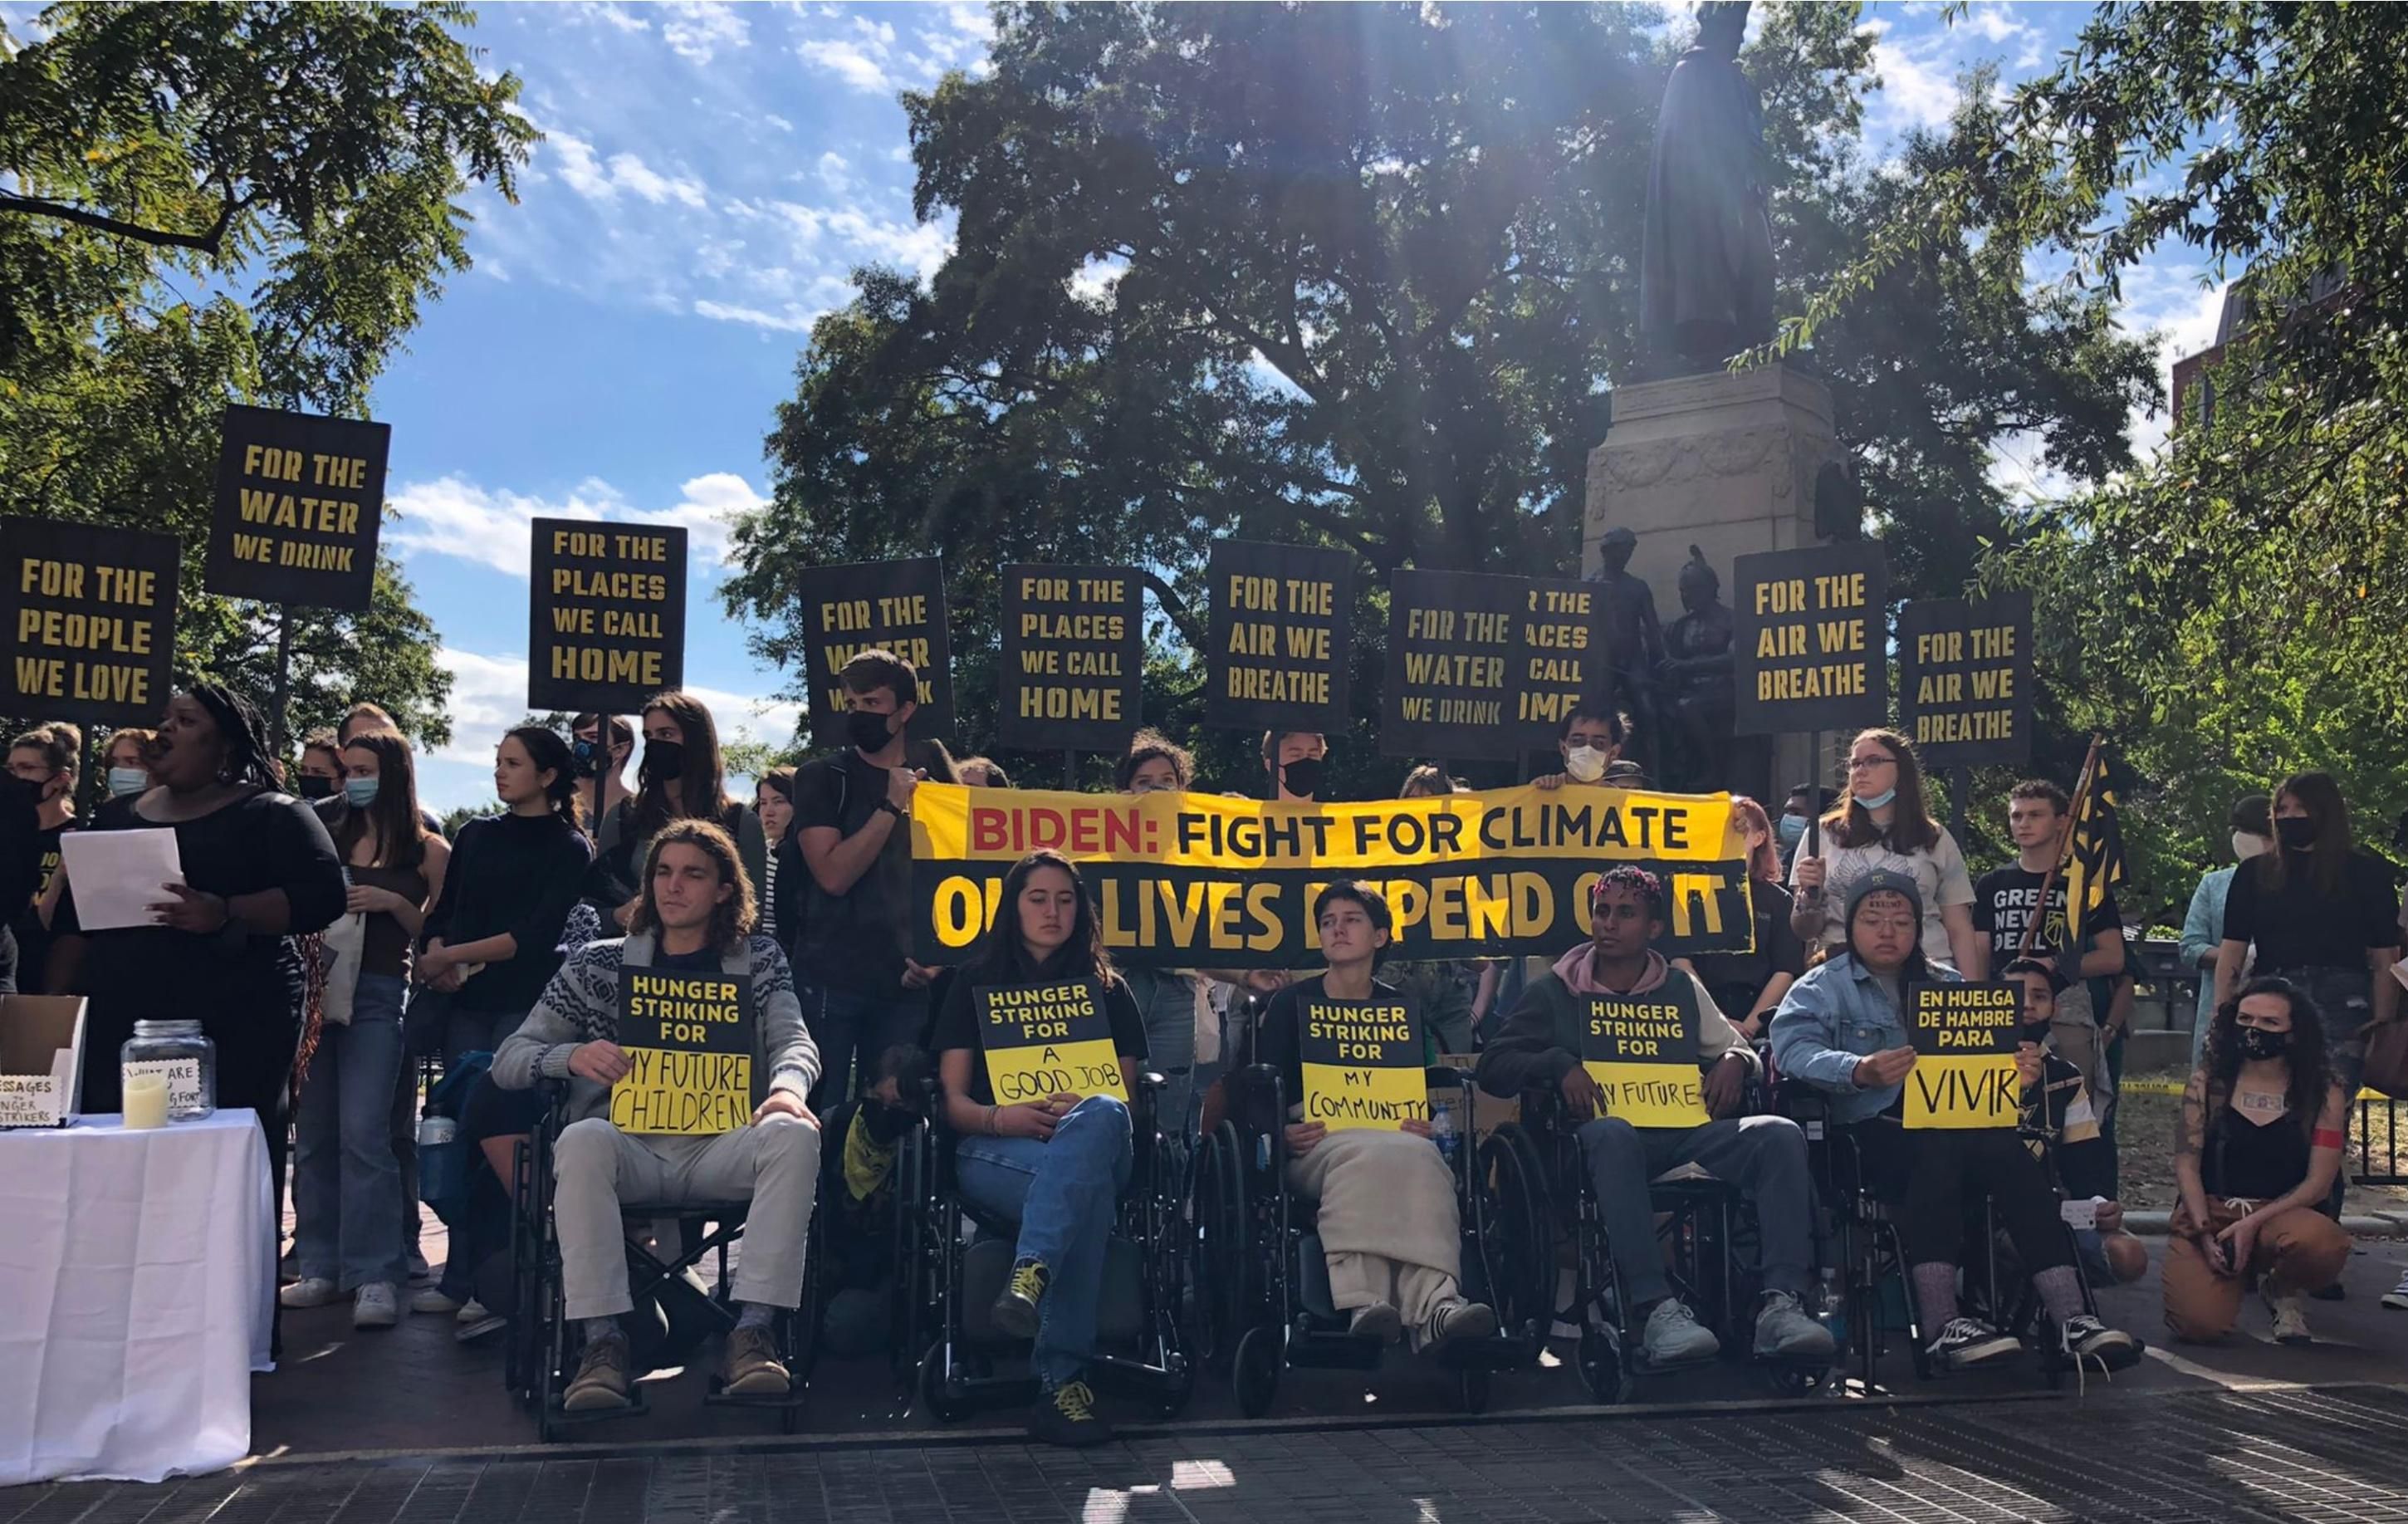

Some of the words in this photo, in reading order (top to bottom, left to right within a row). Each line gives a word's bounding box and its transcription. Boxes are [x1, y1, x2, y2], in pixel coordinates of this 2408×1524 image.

[245, 445, 302, 481] FOR
[314, 454, 366, 488] THE
[241, 488, 359, 534] WATER
[234, 533, 272, 562] WE
[281, 541, 354, 571] DRINK
[554, 532, 604, 557] FOR
[615, 536, 666, 561] THE
[22, 558, 84, 598] FOR
[96, 566, 154, 605] THE
[553, 569, 665, 600] PLACES
[1022, 578, 1069, 600] FOR
[1078, 580, 1123, 602] THE
[1231, 576, 1277, 611] FOR
[1287, 580, 1333, 615] THE
[1756, 580, 1805, 615] FOR
[1815, 574, 1864, 609] THE
[822, 600, 870, 631] FOR
[879, 595, 927, 626] THE
[1546, 592, 1590, 614] THE
[19, 609, 151, 654] PEOPLE
[553, 608, 594, 633] WE
[604, 611, 663, 638] CALL
[1022, 614, 1123, 639] PLACES
[1408, 609, 1454, 639] FOR
[1464, 612, 1510, 643] THE
[1526, 624, 1588, 649] ACES
[1229, 623, 1275, 656] AIR
[1287, 626, 1330, 659] WE
[1757, 625, 1806, 658] AIR
[1818, 620, 1864, 652] WE
[1919, 632, 1962, 664] FOR
[1970, 626, 2014, 659] THE
[552, 646, 662, 684] HOME
[825, 638, 930, 675] WER
[1021, 650, 1058, 674] WE
[1068, 652, 1121, 675] CALL
[1406, 652, 1504, 687] WATER
[1529, 659, 1582, 682] CALL
[17, 657, 65, 696] WE
[75, 663, 148, 703] LOVE
[1229, 667, 1329, 703] BREATHE
[1759, 664, 1865, 700] BREATHE
[1918, 674, 1961, 703] AIR
[1971, 669, 2013, 699] WE
[1020, 687, 1120, 720] HOME
[1402, 698, 1432, 721] WE
[1440, 699, 1500, 724] DRINK
[1917, 710, 2012, 743] BREATHE
[972, 808, 1158, 854] BIDEN:
[1177, 813, 1335, 858] FIGHT
[1353, 813, 1463, 855] FOR
[1480, 804, 1689, 850] CLIMATE
[1101, 878, 1285, 952] LIVES
[1304, 870, 1554, 948] PEND
[1671, 873, 1726, 937] IT
[1994, 889, 2067, 909] GREEN
[634, 976, 737, 1001] HUNGER
[989, 985, 1088, 1007] HUNGER
[1921, 992, 1942, 1007] EN
[1949, 990, 2014, 1007] HUELGA
[631, 997, 738, 1022] STRIKING
[991, 1001, 1094, 1023] STRIKING
[1311, 1005, 1406, 1022] HUNGER
[1592, 1002, 1679, 1020] HUNGER
[1919, 1012, 1941, 1027] DE
[1946, 1010, 2014, 1027] HAMBRE
[661, 1022, 705, 1042] FOR
[1023, 1022, 1068, 1038] FOR
[1310, 1022, 1409, 1041] STRIKING
[1591, 1020, 1683, 1038] STRIKING
[1939, 1030, 1994, 1046] PARA
[1043, 1046, 1061, 1063] A
[1339, 1043, 1382, 1059] FOR
[1618, 1040, 1657, 1055] FOR
[168, 1066, 193, 1080] ARE
[660, 1051, 749, 1090] FUTURE
[1000, 1069, 1073, 1100] GOOD
[1074, 1063, 1121, 1090] JOB
[1344, 1070, 1373, 1087] MY
[0, 1080, 51, 1096] SSAGES
[1622, 1080, 1699, 1108] FUTURE
[1916, 1069, 2019, 1116] VIVIR
[0, 1100, 36, 1114] NGER
[611, 1089, 747, 1131] CHILDREN
[1309, 1090, 1426, 1120] COMMUNITY
